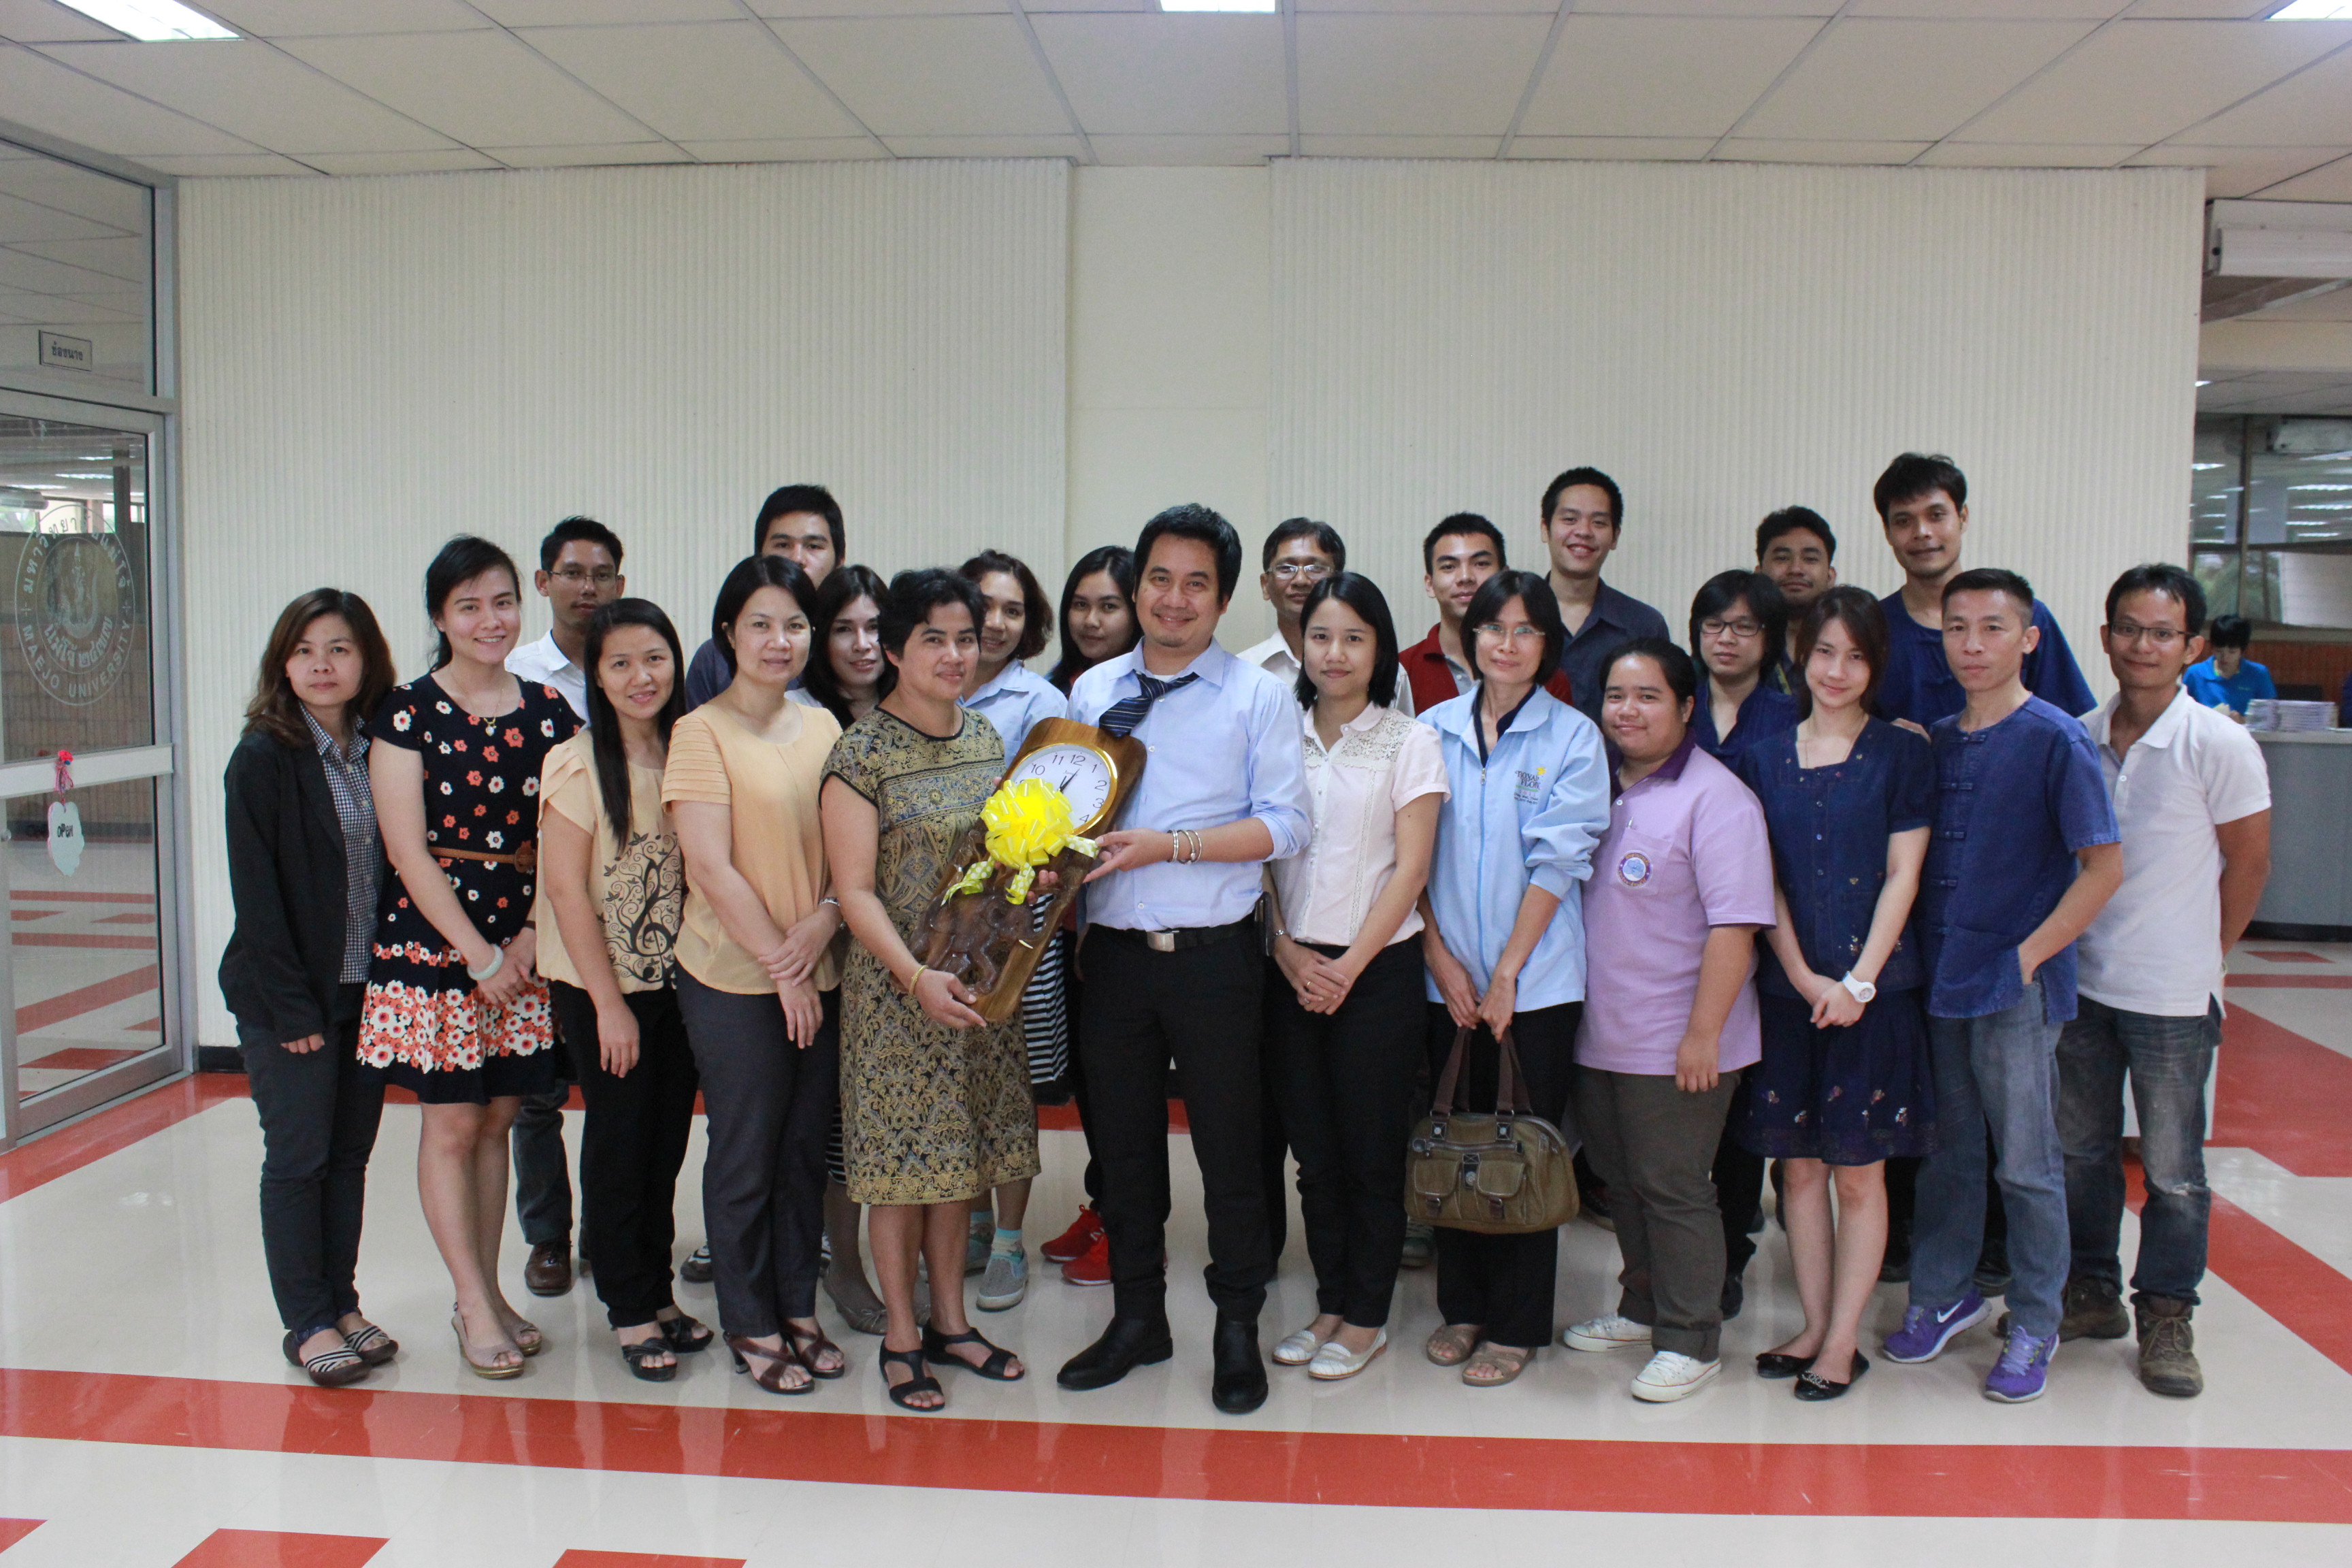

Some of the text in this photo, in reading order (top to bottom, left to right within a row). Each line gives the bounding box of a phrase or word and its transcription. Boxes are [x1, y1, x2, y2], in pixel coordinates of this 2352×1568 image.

[22, 620, 130, 698] MAEJO UNIVERSITY
[1052, 754, 1064, 765] 11
[1071, 753, 1085, 766] 12
[1030, 764, 1045, 775] 10
[1092, 764, 1098, 773] 1
[1094, 780, 1107, 791] 2
[1092, 798, 1105, 808] 3
[1079, 814, 1090, 823] 4
